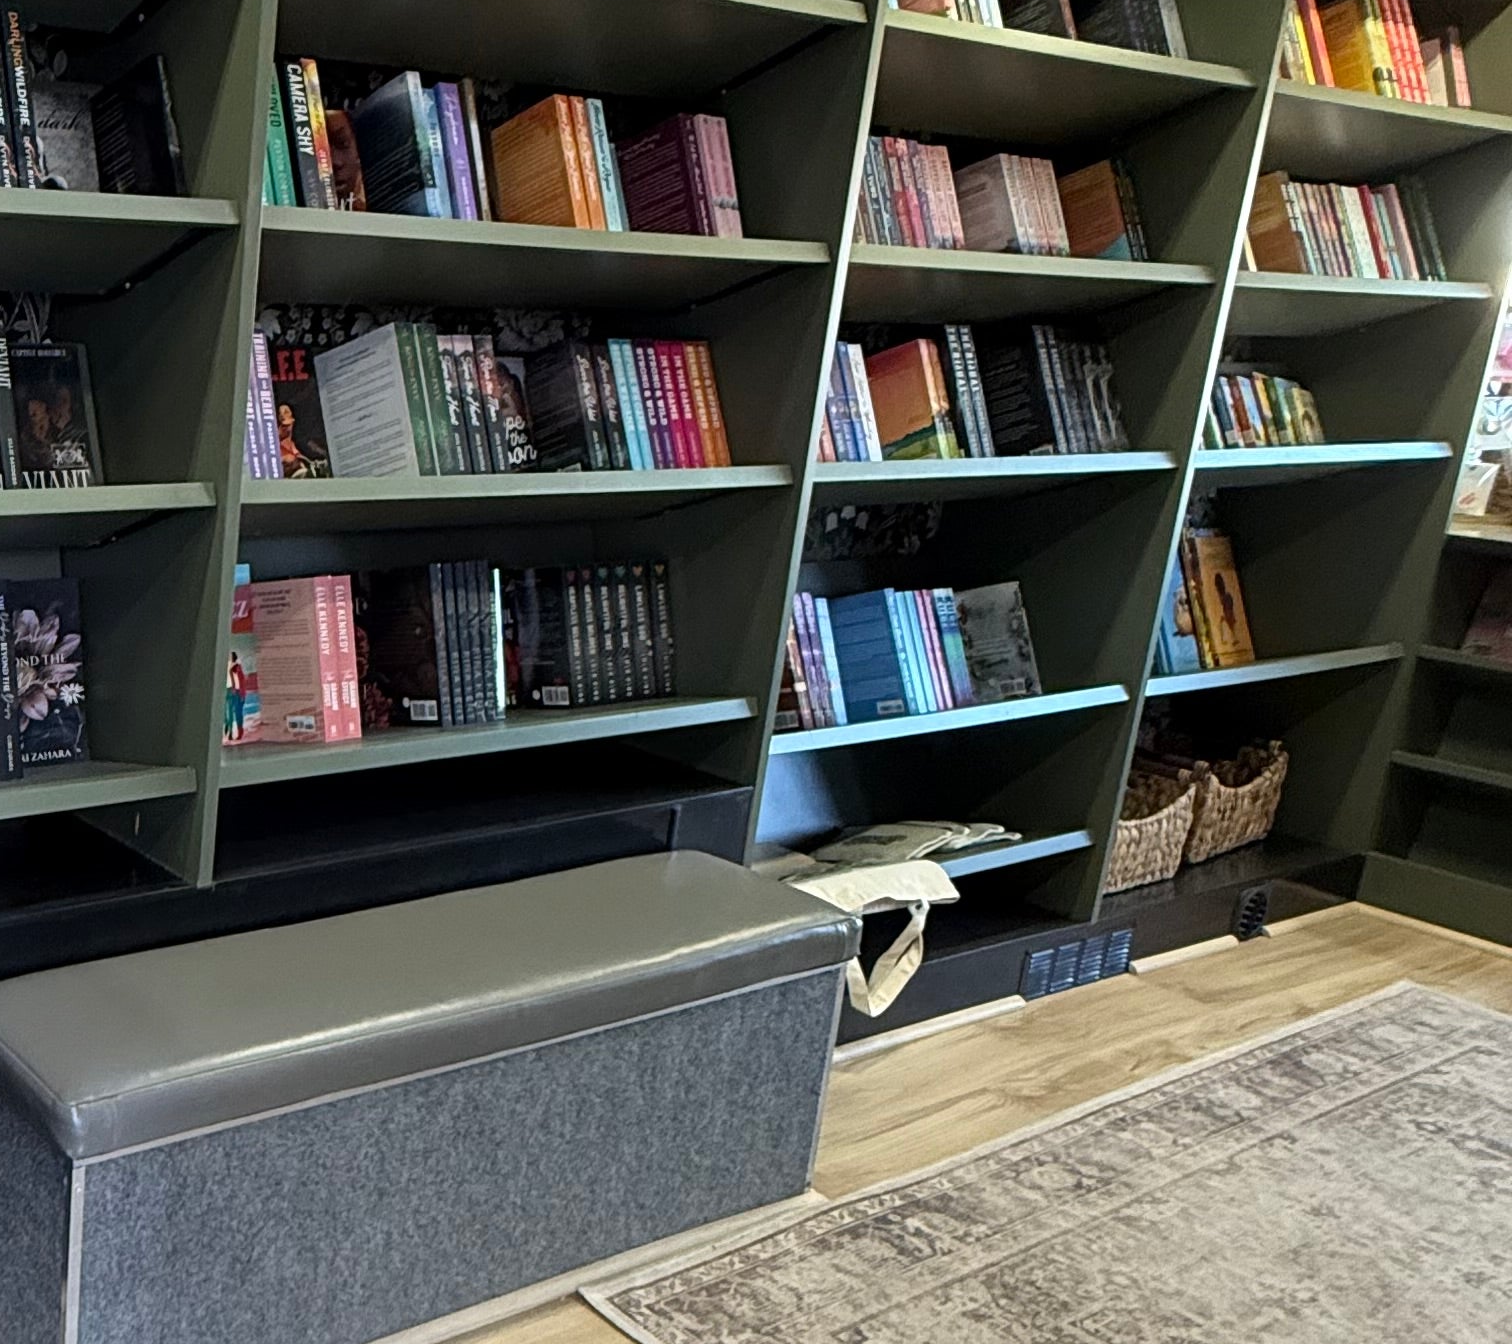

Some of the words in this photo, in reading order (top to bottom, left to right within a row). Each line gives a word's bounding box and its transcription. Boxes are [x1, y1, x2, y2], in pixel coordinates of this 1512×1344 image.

[287, 63, 309, 123] CAMERA
[296, 127, 315, 156] SHY
[253, 332, 269, 379] TRAINING
[659, 354, 668, 367] IN
[673, 354, 682, 367] IN
[635, 346, 649, 388] STRONG
[645, 398, 657, 426] WILD
[646, 346, 660, 388] STRONG
[655, 397, 667, 426] WILD
[661, 368, 672, 389] THE
[675, 368, 686, 389] THE
[260, 390, 275, 420] HEART
[666, 390, 678, 420] GAME
[680, 390, 692, 419] GAME
[510, 432, 528, 447] the
[315, 586, 326, 608] ELLE
[334, 585, 345, 607] ELLE
[317, 610, 330, 655] KENNEDY
[336, 608, 349, 653] KENNEDY
[0, 642, 10, 675] BEYOND
[42, 654, 67, 666] THE
[2, 674, 11, 694] THE
[32, 749, 71, 763] ZAHARA
